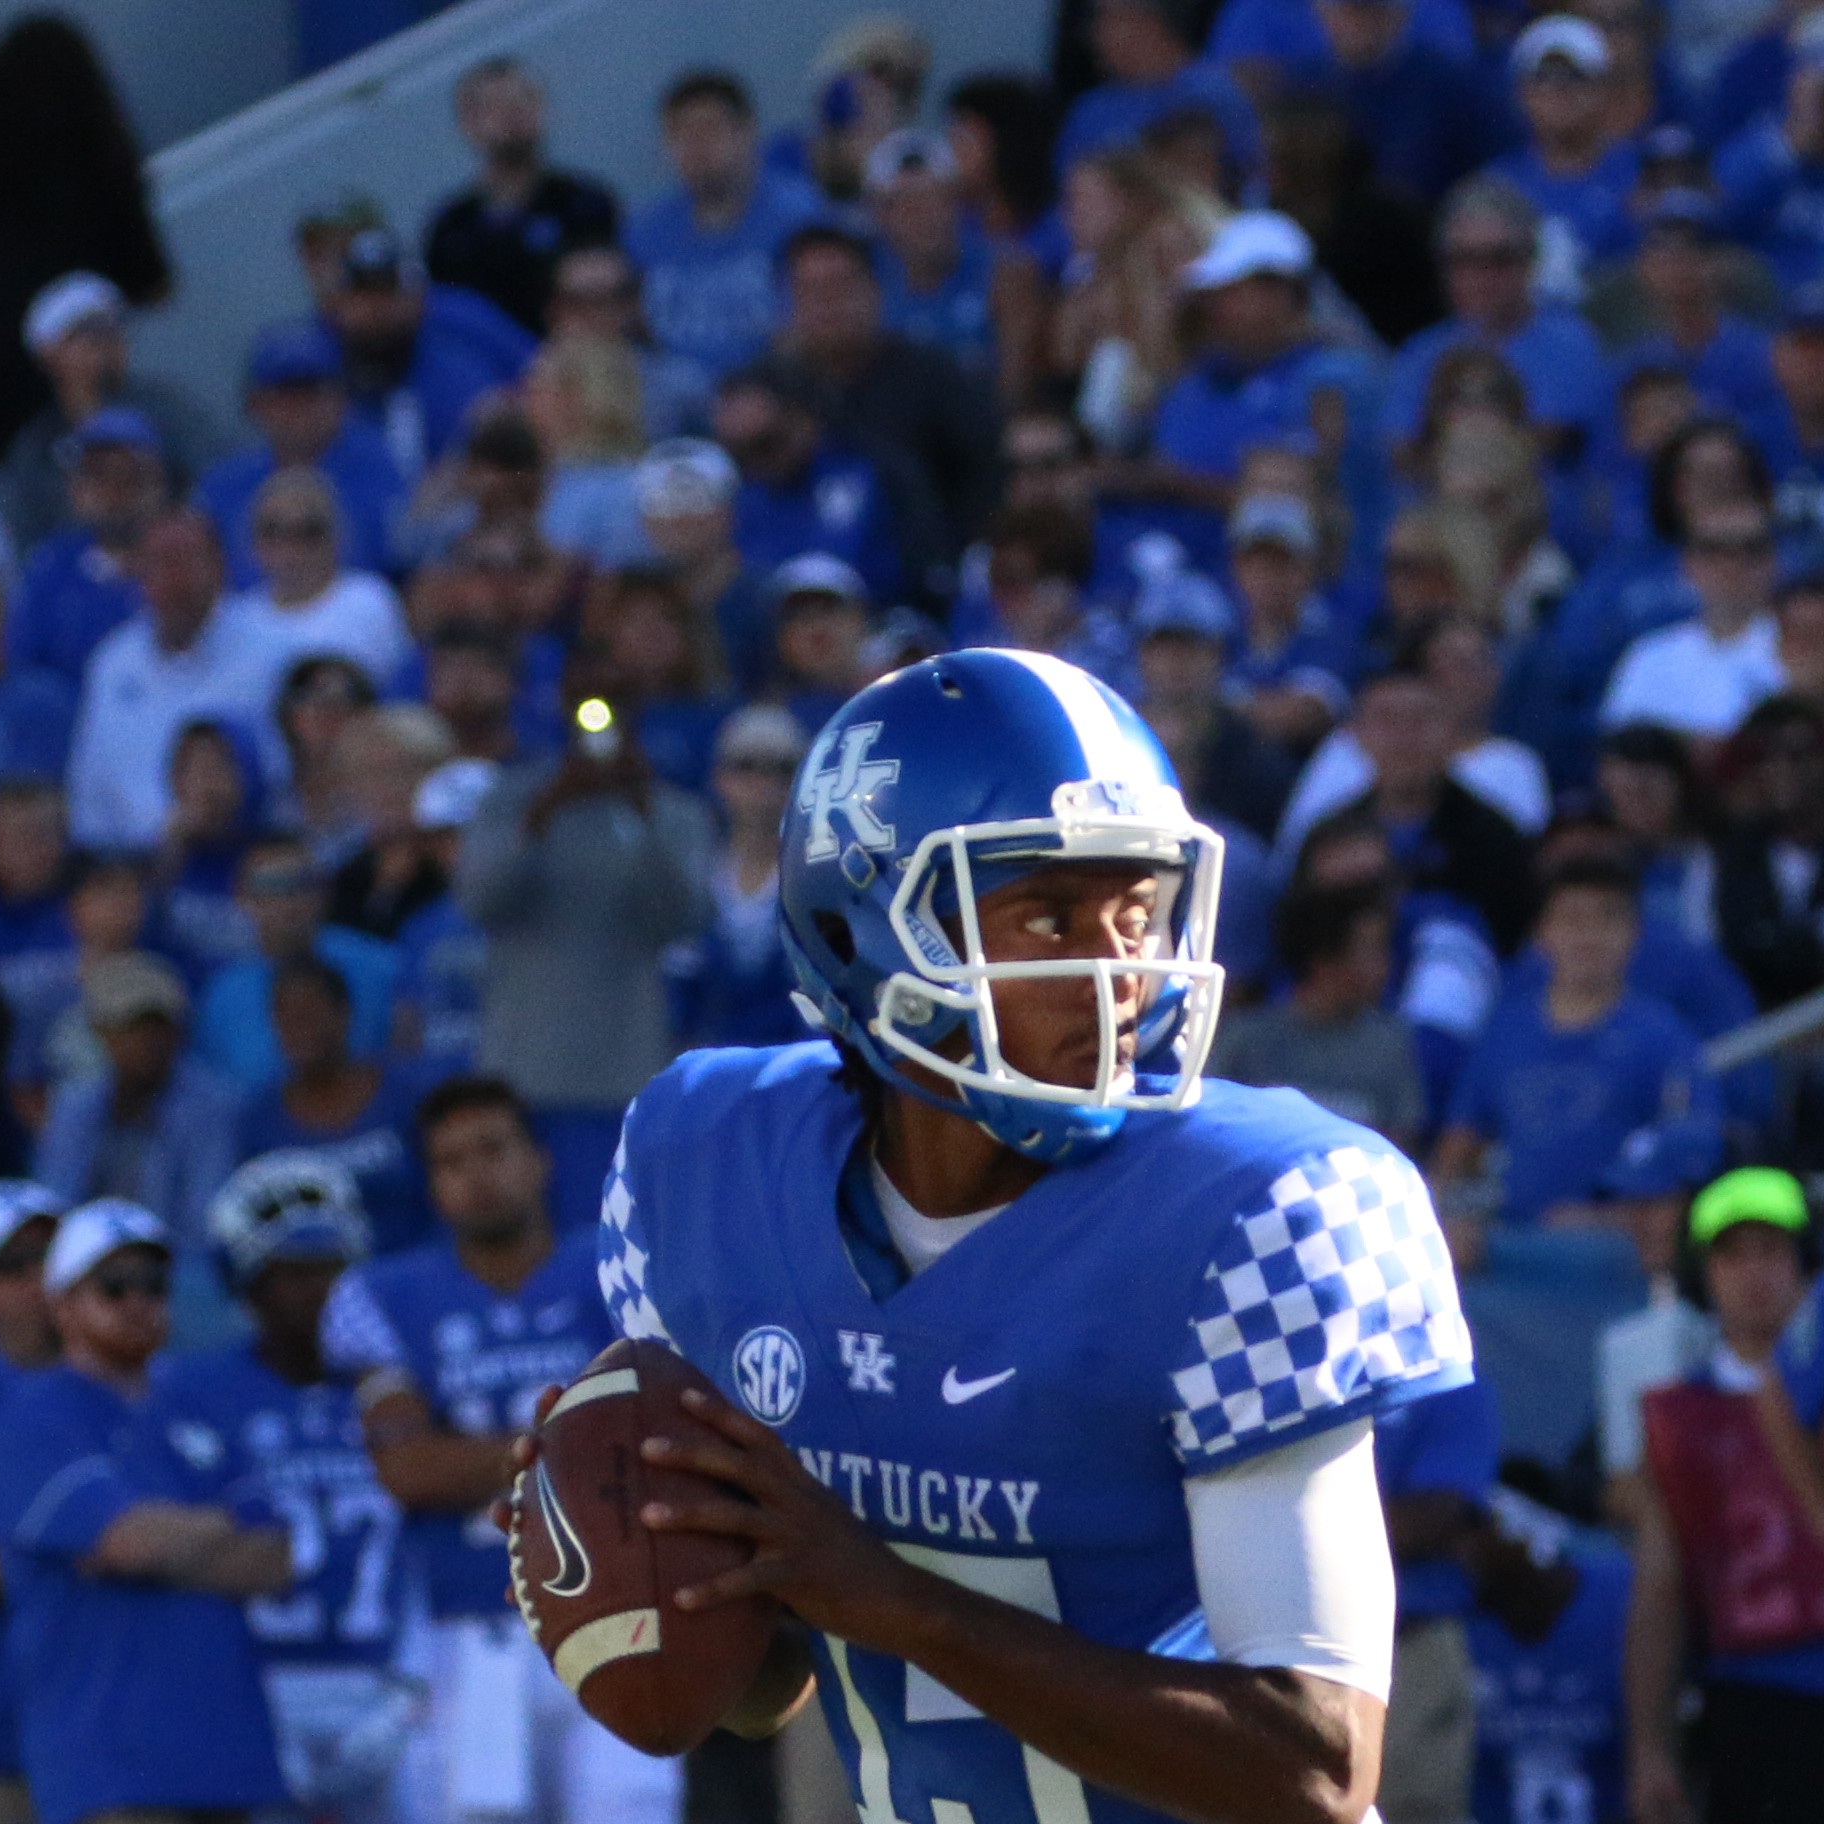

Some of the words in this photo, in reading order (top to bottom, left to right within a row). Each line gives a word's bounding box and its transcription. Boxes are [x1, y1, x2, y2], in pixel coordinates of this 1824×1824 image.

[797, 721, 901, 864] UK
[739, 1333, 798, 1417] SEC
[837, 1329, 897, 1394] UK
[785, 1443, 1040, 1545] NTUCKY
